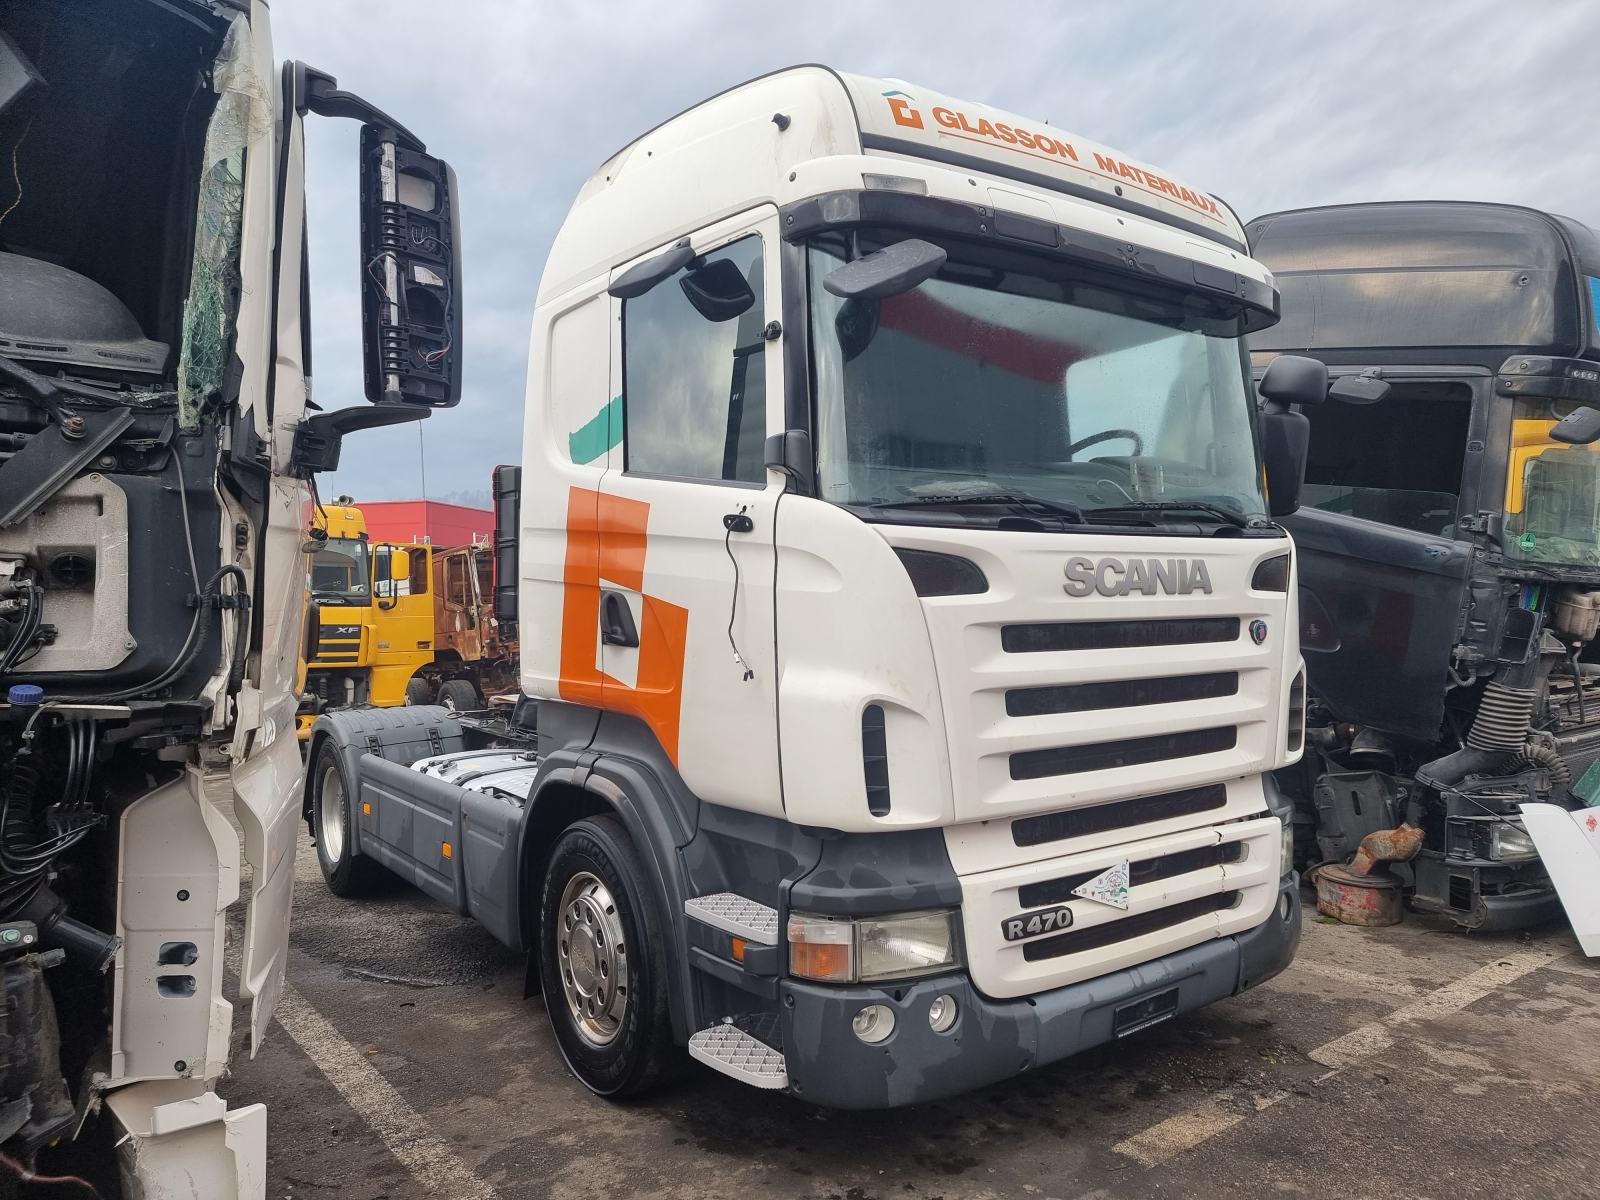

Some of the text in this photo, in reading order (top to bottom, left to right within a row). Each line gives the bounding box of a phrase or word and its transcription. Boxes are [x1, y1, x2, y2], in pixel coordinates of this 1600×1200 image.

[932, 107, 1223, 217] GLASSON MATERIAUX
[1063, 556, 1213, 597] SCANIA
[1008, 909, 1071, 940] R 470
